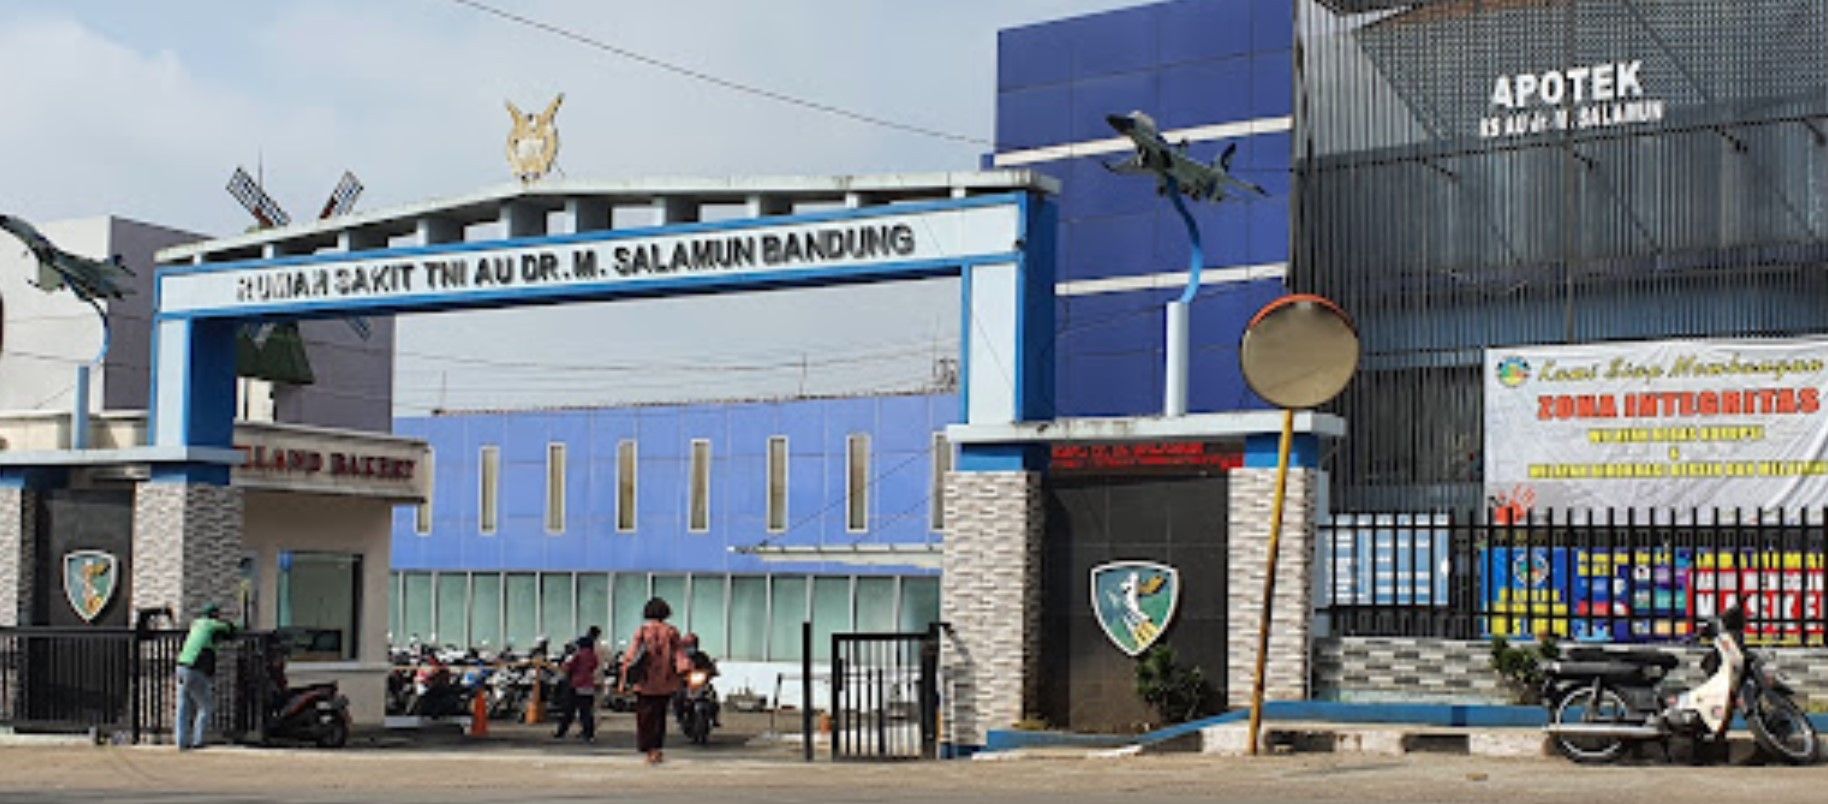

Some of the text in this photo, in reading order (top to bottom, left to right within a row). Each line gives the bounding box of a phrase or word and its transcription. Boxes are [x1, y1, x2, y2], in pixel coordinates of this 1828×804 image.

[1492, 60, 1643, 108] APOTEK
[1578, 100, 1664, 129] SALAMUN
[237, 268, 328, 301] RUMAH
[335, 262, 414, 295] SAKIT
[424, 260, 467, 289] TNI
[474, 257, 513, 285] AU
[613, 236, 756, 276] SALAMUN
[762, 224, 915, 266] BANDUNG
[1537, 387, 1821, 421] ZONA INTEGRITAS
[330, 453, 416, 480] BAKERY
